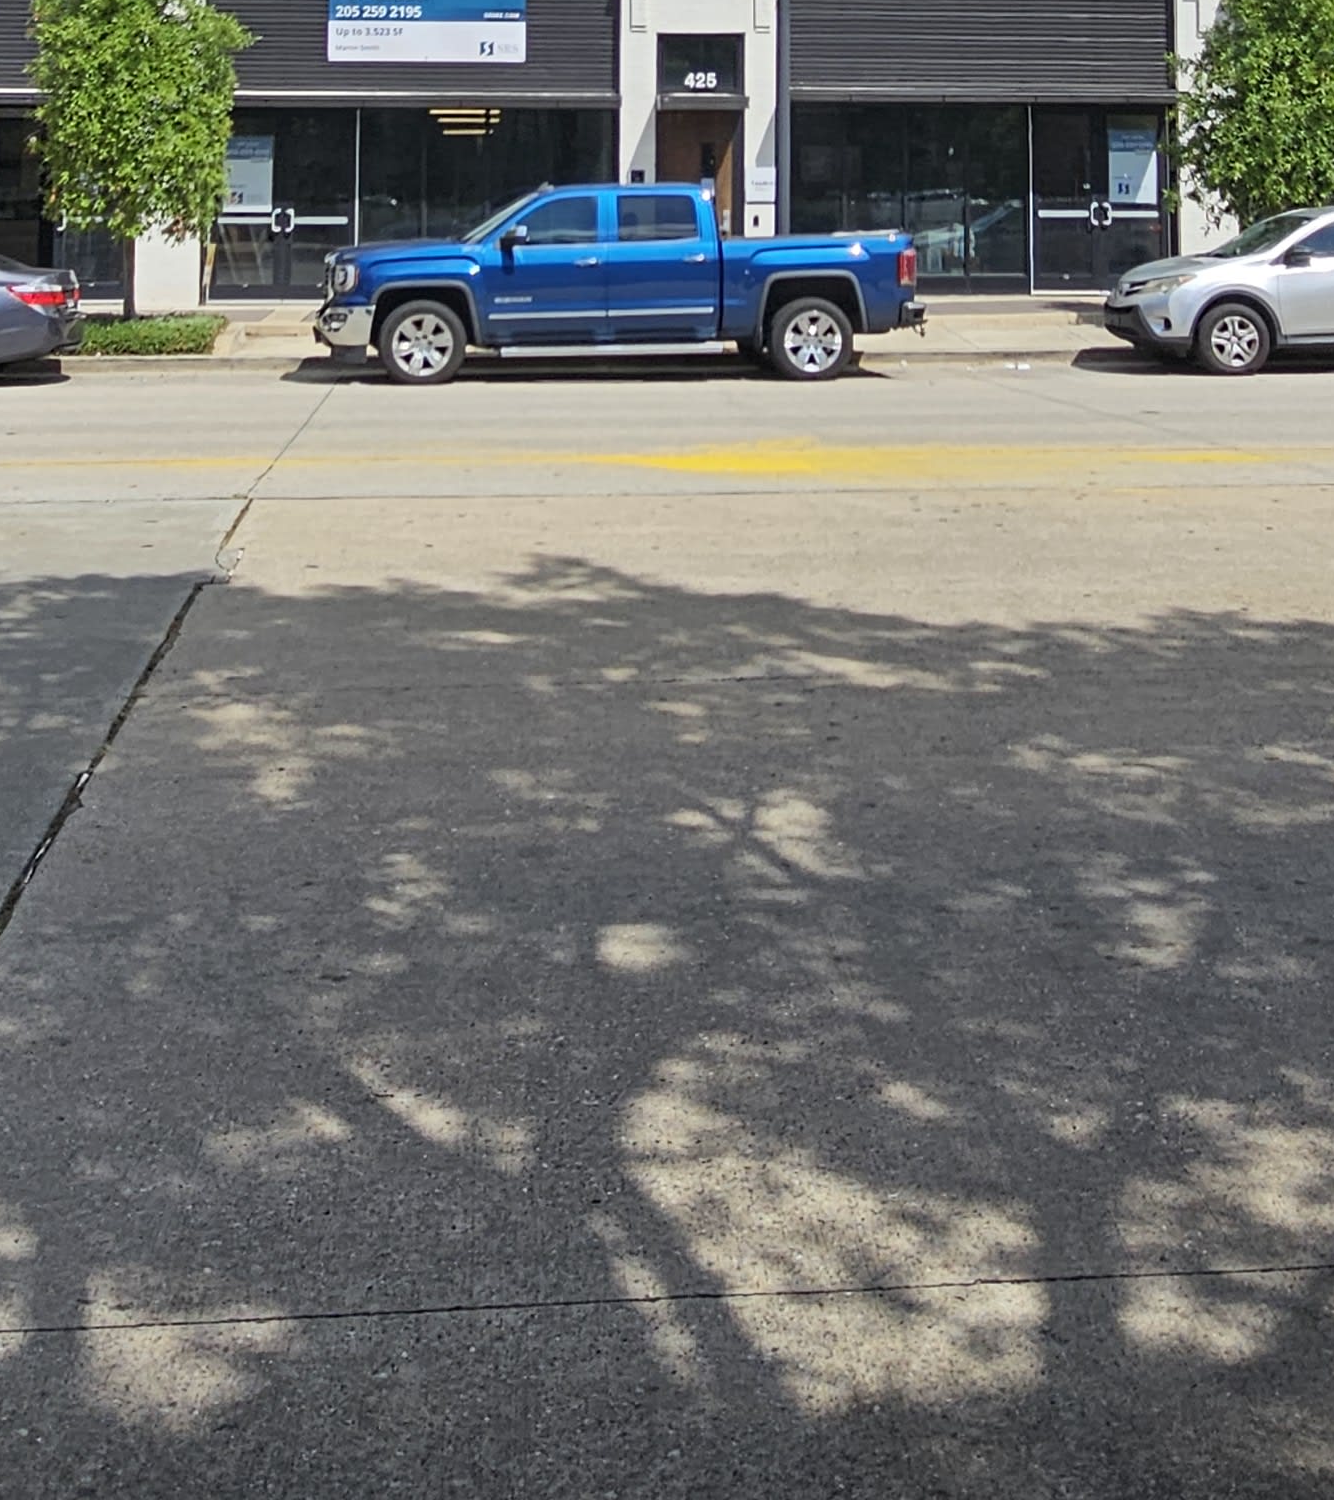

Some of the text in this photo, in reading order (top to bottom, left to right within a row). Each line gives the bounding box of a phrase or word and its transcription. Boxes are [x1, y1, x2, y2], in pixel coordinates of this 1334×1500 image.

[335, 5, 422, 18] 205 259 2195
[335, 28, 350, 39] Up
[352, 28, 363, 36] to
[684, 71, 718, 89] 425
